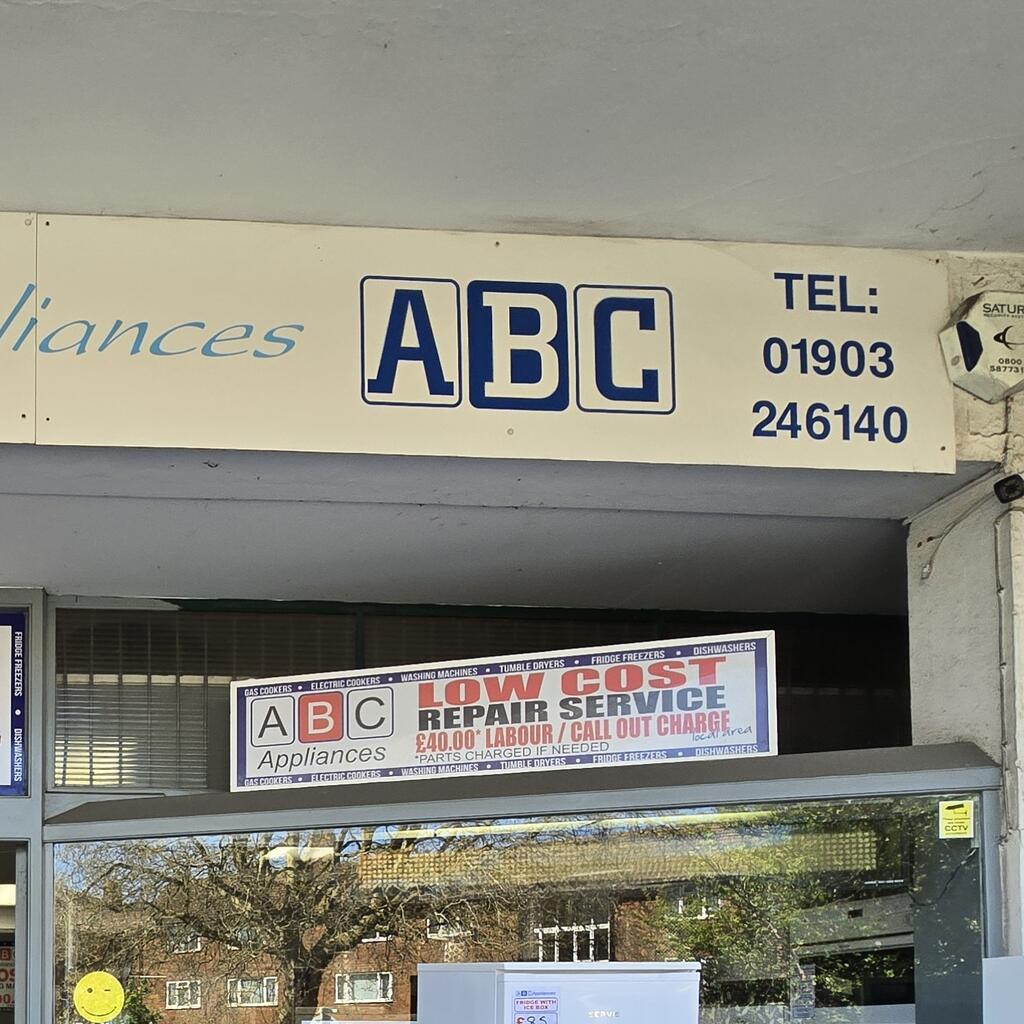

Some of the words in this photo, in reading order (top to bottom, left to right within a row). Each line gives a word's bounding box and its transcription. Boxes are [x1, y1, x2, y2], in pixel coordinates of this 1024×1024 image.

[773, 272, 878, 314] TEL:
[365, 286, 662, 405] ABC
[762, 337, 895, 378] 01903
[752, 400, 908, 444] 246140
[14, 631, 23, 657] FRIDGE
[693, 641, 757, 656] DISHWASHERS
[499, 663, 532, 673] TUMBLE
[533, 659, 565, 670] DRYERS
[591, 654, 621, 665] FRIDGE
[622, 650, 666, 662] FREEZERS
[14, 658, 23, 697] FREEZERS
[310, 679, 345, 691] ELECTRIC
[346, 676, 381, 687] COOKERS
[400, 671, 436, 682] WASHING
[437, 667, 478, 679] MACHINES
[417, 672, 545, 709] LOW
[561, 656, 726, 696] COST
[244, 687, 259, 697] GAS
[259, 685, 292, 696] COOKERS
[255, 693, 387, 741] ABC
[418, 700, 548, 732] REPAIR
[559, 685, 725, 721] SERVICE
[485, 724, 553, 748] LABOUR
[557, 722, 567, 744] /
[570, 718, 612, 742] CALL
[616, 716, 652, 738] OUT
[656, 710, 730, 736] CHARGE
[692, 728, 719, 742] local
[14, 728, 23, 782] DISHWASHERS
[257, 746, 386, 773] Appliances
[464, 746, 531, 762] CHARGED
[536, 745, 549, 756] IF
[550, 741, 610, 755] NEEDED
[592, 753, 622, 764] FRIDGE
[623, 750, 667, 761] FREEZERS
[694, 744, 758, 757] DISHWASHERS
[401, 766, 437, 776] WASHING
[437, 763, 479, 774] MACHINES
[500, 759, 533, 770] TUMBLE
[534, 757, 566, 768] DRYERS
[244, 777, 259, 786] GAS
[259, 775, 293, 786] COOKERS
[311, 772, 346, 782] ELECTRIC
[346, 769, 381, 780] COOKERS
